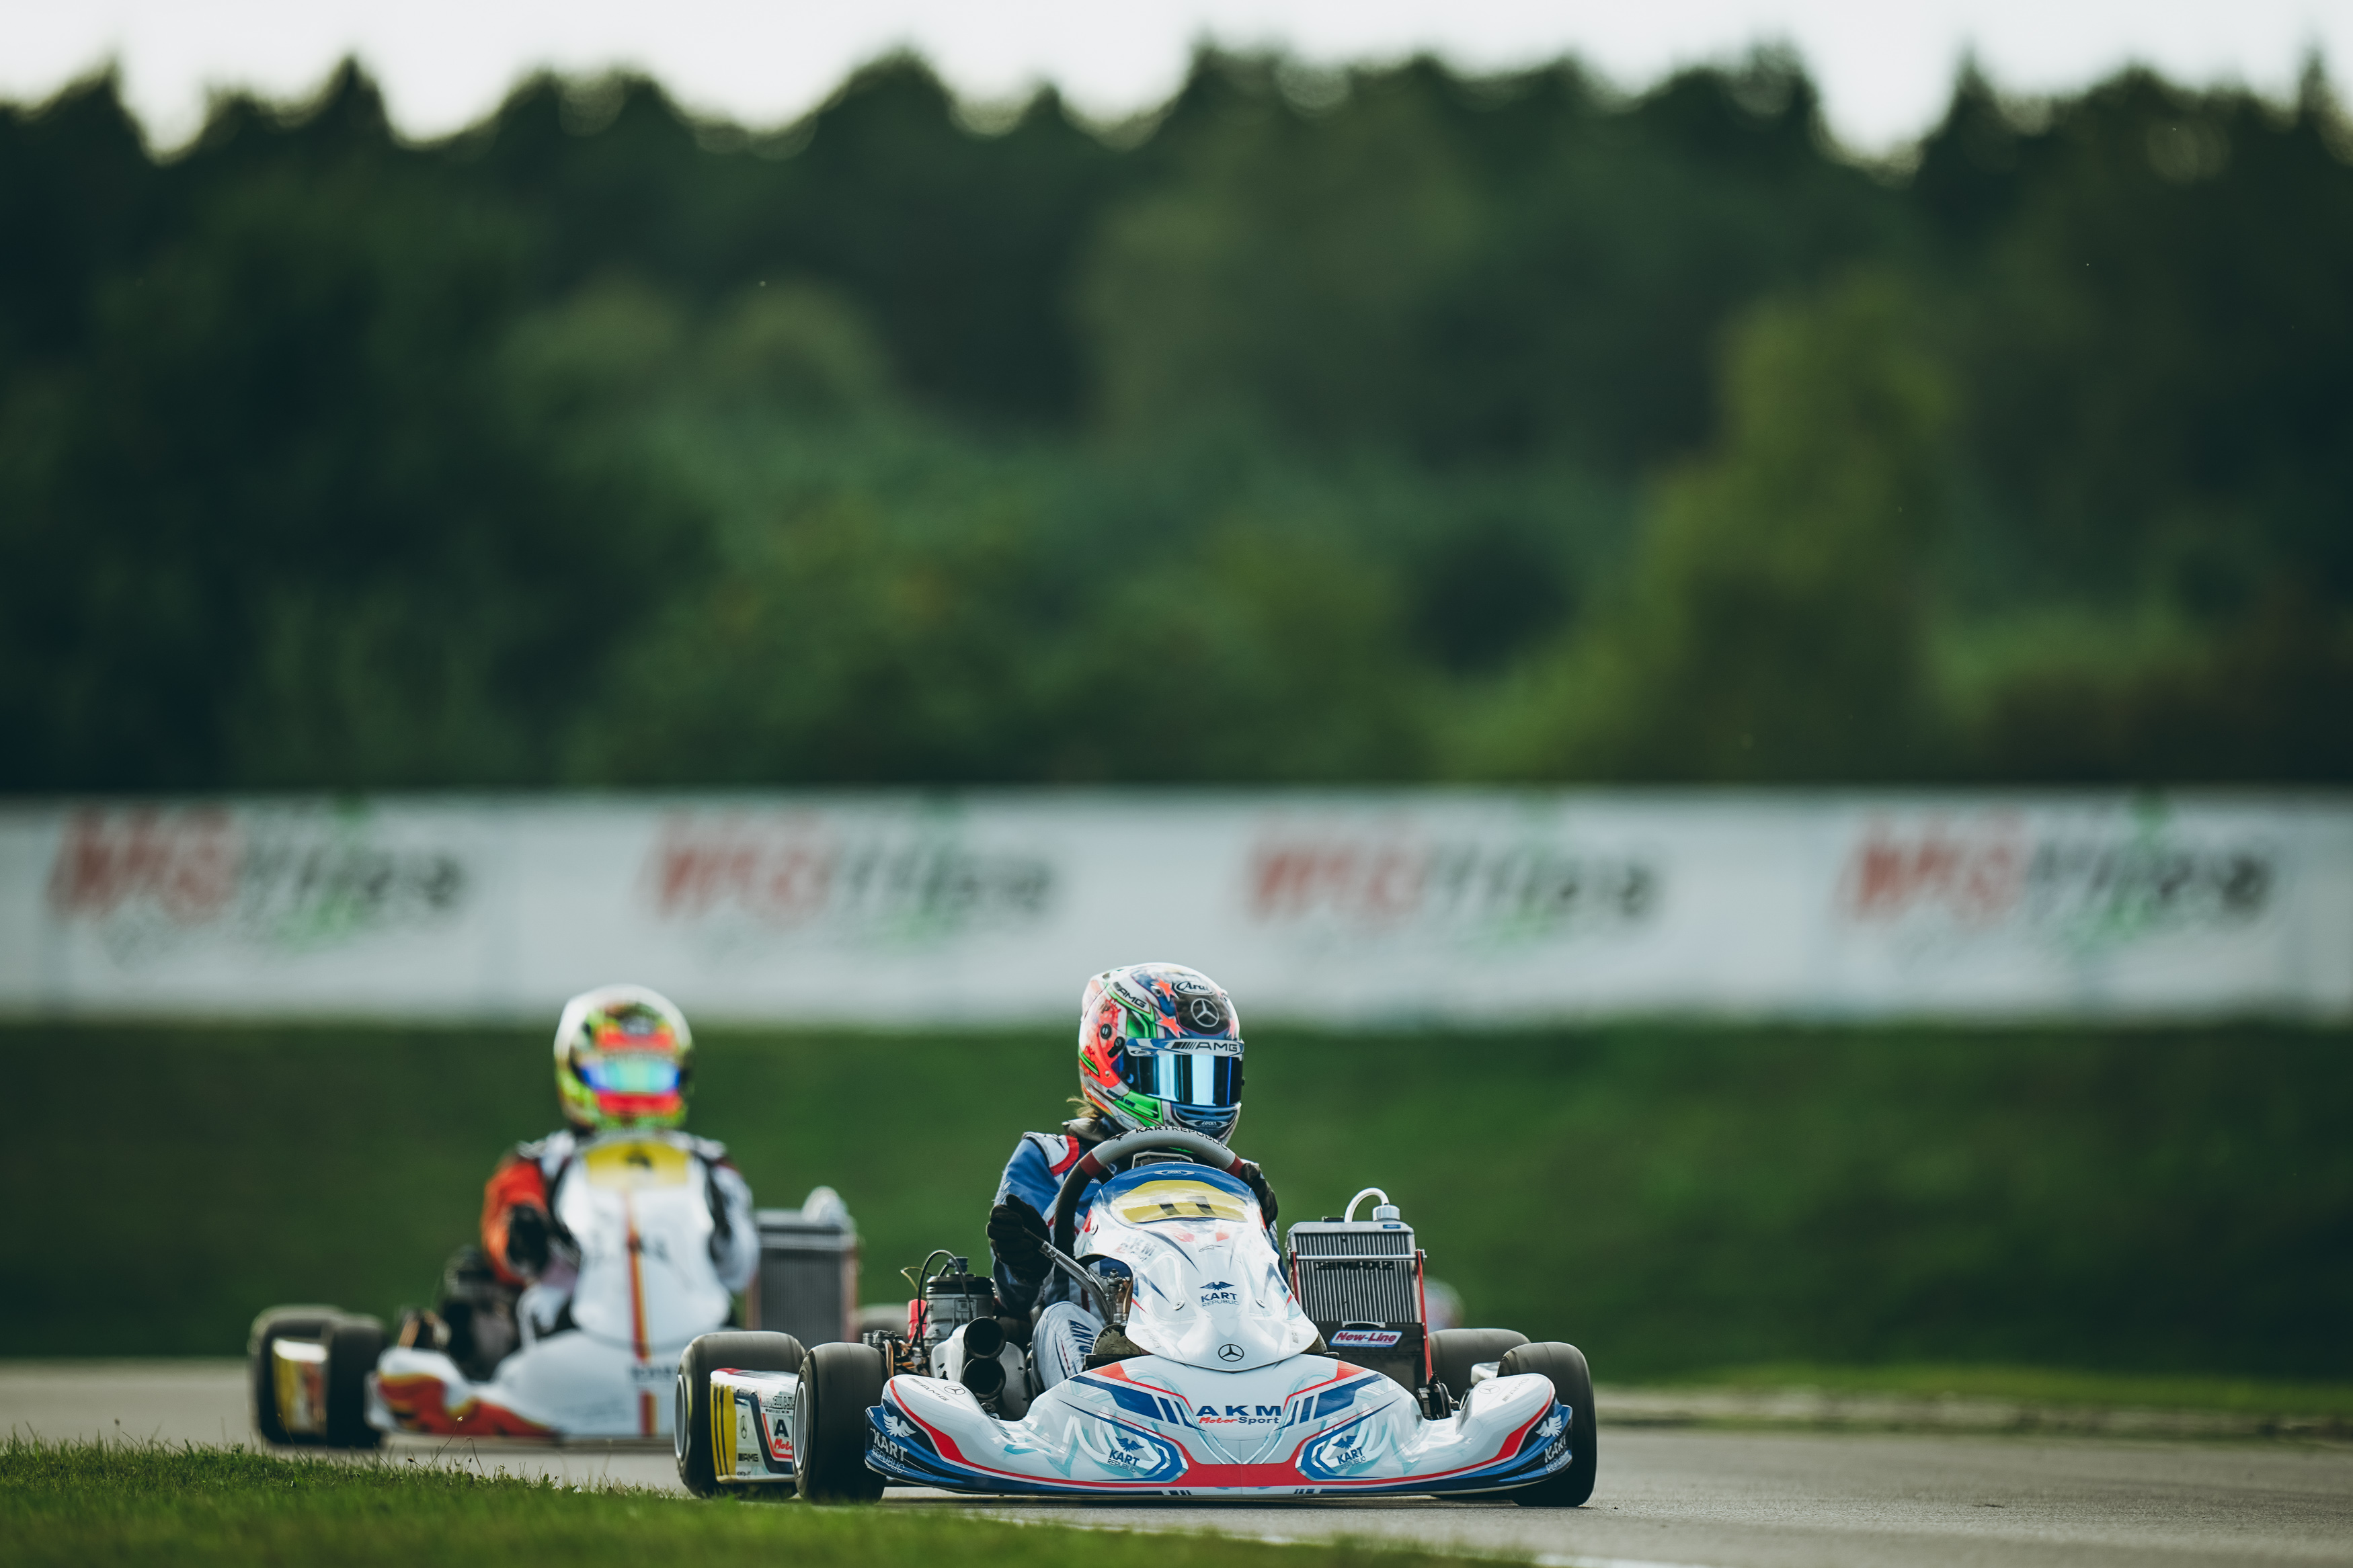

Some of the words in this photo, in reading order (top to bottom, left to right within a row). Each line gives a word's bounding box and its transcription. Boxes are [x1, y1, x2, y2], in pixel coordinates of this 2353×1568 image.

[1117, 987, 1147, 1008] AMG
[1195, 1041, 1238, 1053] AMG
[1148, 1195, 1218, 1216] 11
[1201, 1292, 1237, 1303] KART
[1201, 1299, 1240, 1307] REPUBLIC
[1335, 1332, 1397, 1342] New-Line
[919, 1385, 949, 1401] AMG
[1509, 1378, 1530, 1395] AMG
[1196, 1405, 1281, 1416] AKM
[873, 1432, 908, 1461] KART
[1544, 1435, 1566, 1463] KART
[744, 1453, 759, 1462] AMG
[873, 1445, 906, 1473] REPUBLIC
[1109, 1449, 1140, 1467] KART
[1337, 1446, 1363, 1464] KART
[1341, 1456, 1366, 1470] REPUBLIC
[1107, 1458, 1136, 1473] REPUBLIC
